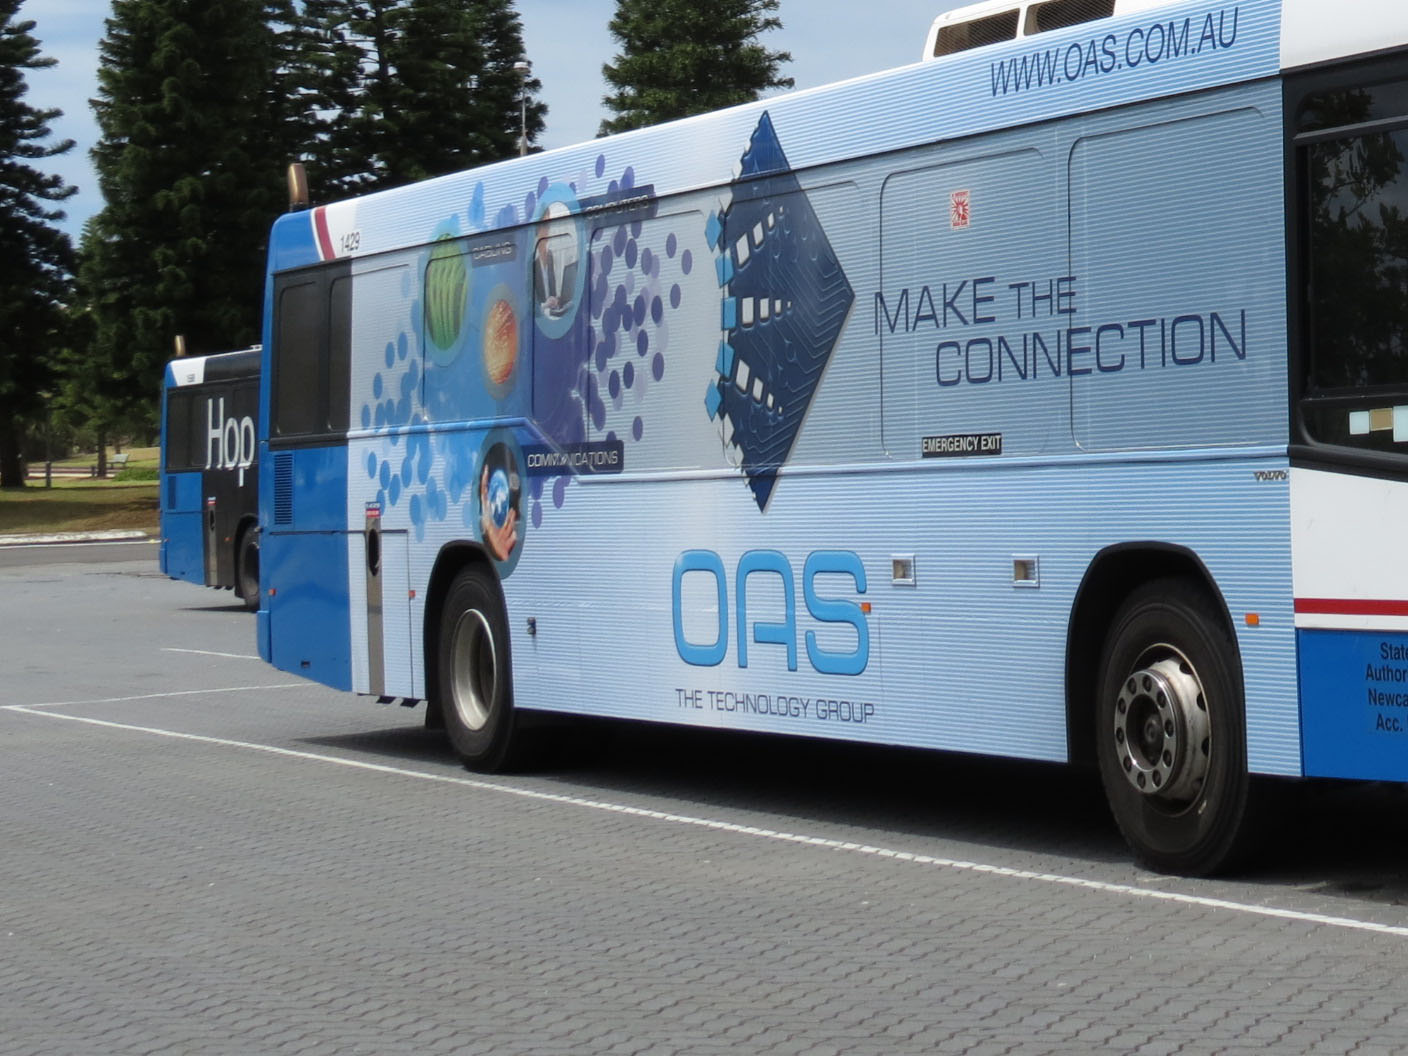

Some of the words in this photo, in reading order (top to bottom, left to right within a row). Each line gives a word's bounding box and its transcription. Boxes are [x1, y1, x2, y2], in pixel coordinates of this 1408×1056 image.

[990, 6, 1240, 97] WWW.OAS.COM.AU
[341, 231, 360, 253] 1429
[874, 277, 996, 335] MAKE
[1009, 276, 1077, 320] THE
[936, 309, 1247, 387] CONNECTION
[205, 397, 256, 487] Hop
[923, 435, 979, 453] EMERGENCY
[980, 433, 1001, 451] EXIT
[1254, 470, 1288, 482] VOLVO
[672, 549, 870, 676] OAS
[675, 688, 703, 709] THE
[707, 690, 810, 719] TECHNOLOGY
[816, 699, 875, 723] GROUP
[1376, 713, 1403, 732] Acc.
